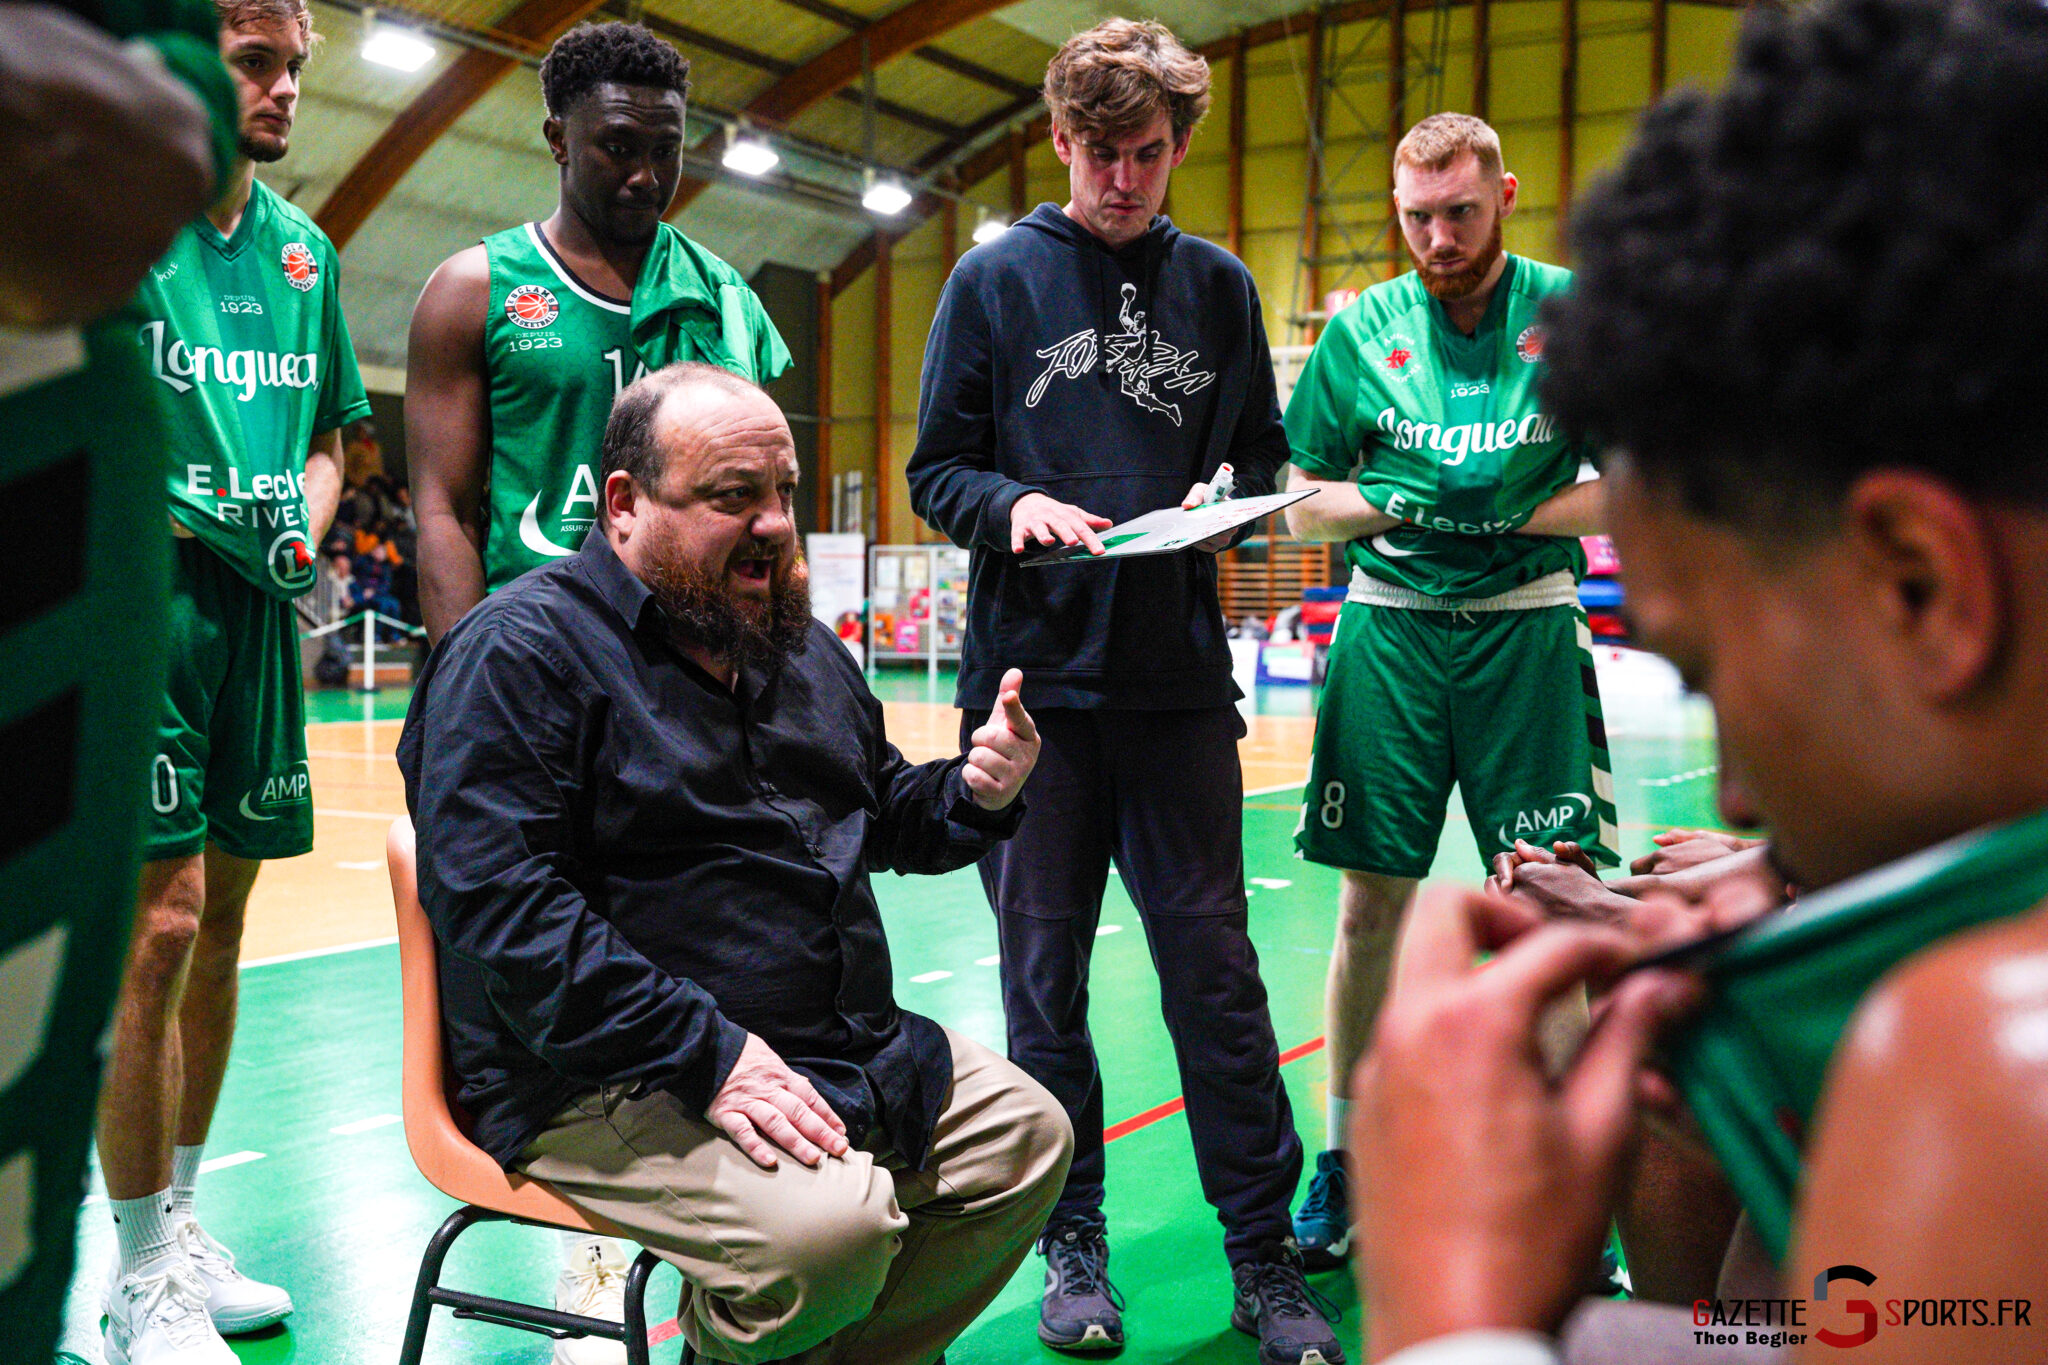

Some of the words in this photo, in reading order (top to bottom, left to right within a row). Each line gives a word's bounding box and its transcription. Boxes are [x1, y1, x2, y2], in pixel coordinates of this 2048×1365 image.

[507, 286, 555, 304] ESCLAMS
[220, 301, 263, 315] 1923
[510, 312, 556, 328] BASKETBALL
[515, 331, 556, 339] DEPUIS
[509, 337, 563, 352] 1923
[136, 320, 319, 402] Longuea
[1450, 383, 1490, 399] 1923
[261, 773, 308, 801] AMP
[1321, 781, 1346, 829] 8
[1515, 805, 1574, 833] AMP
